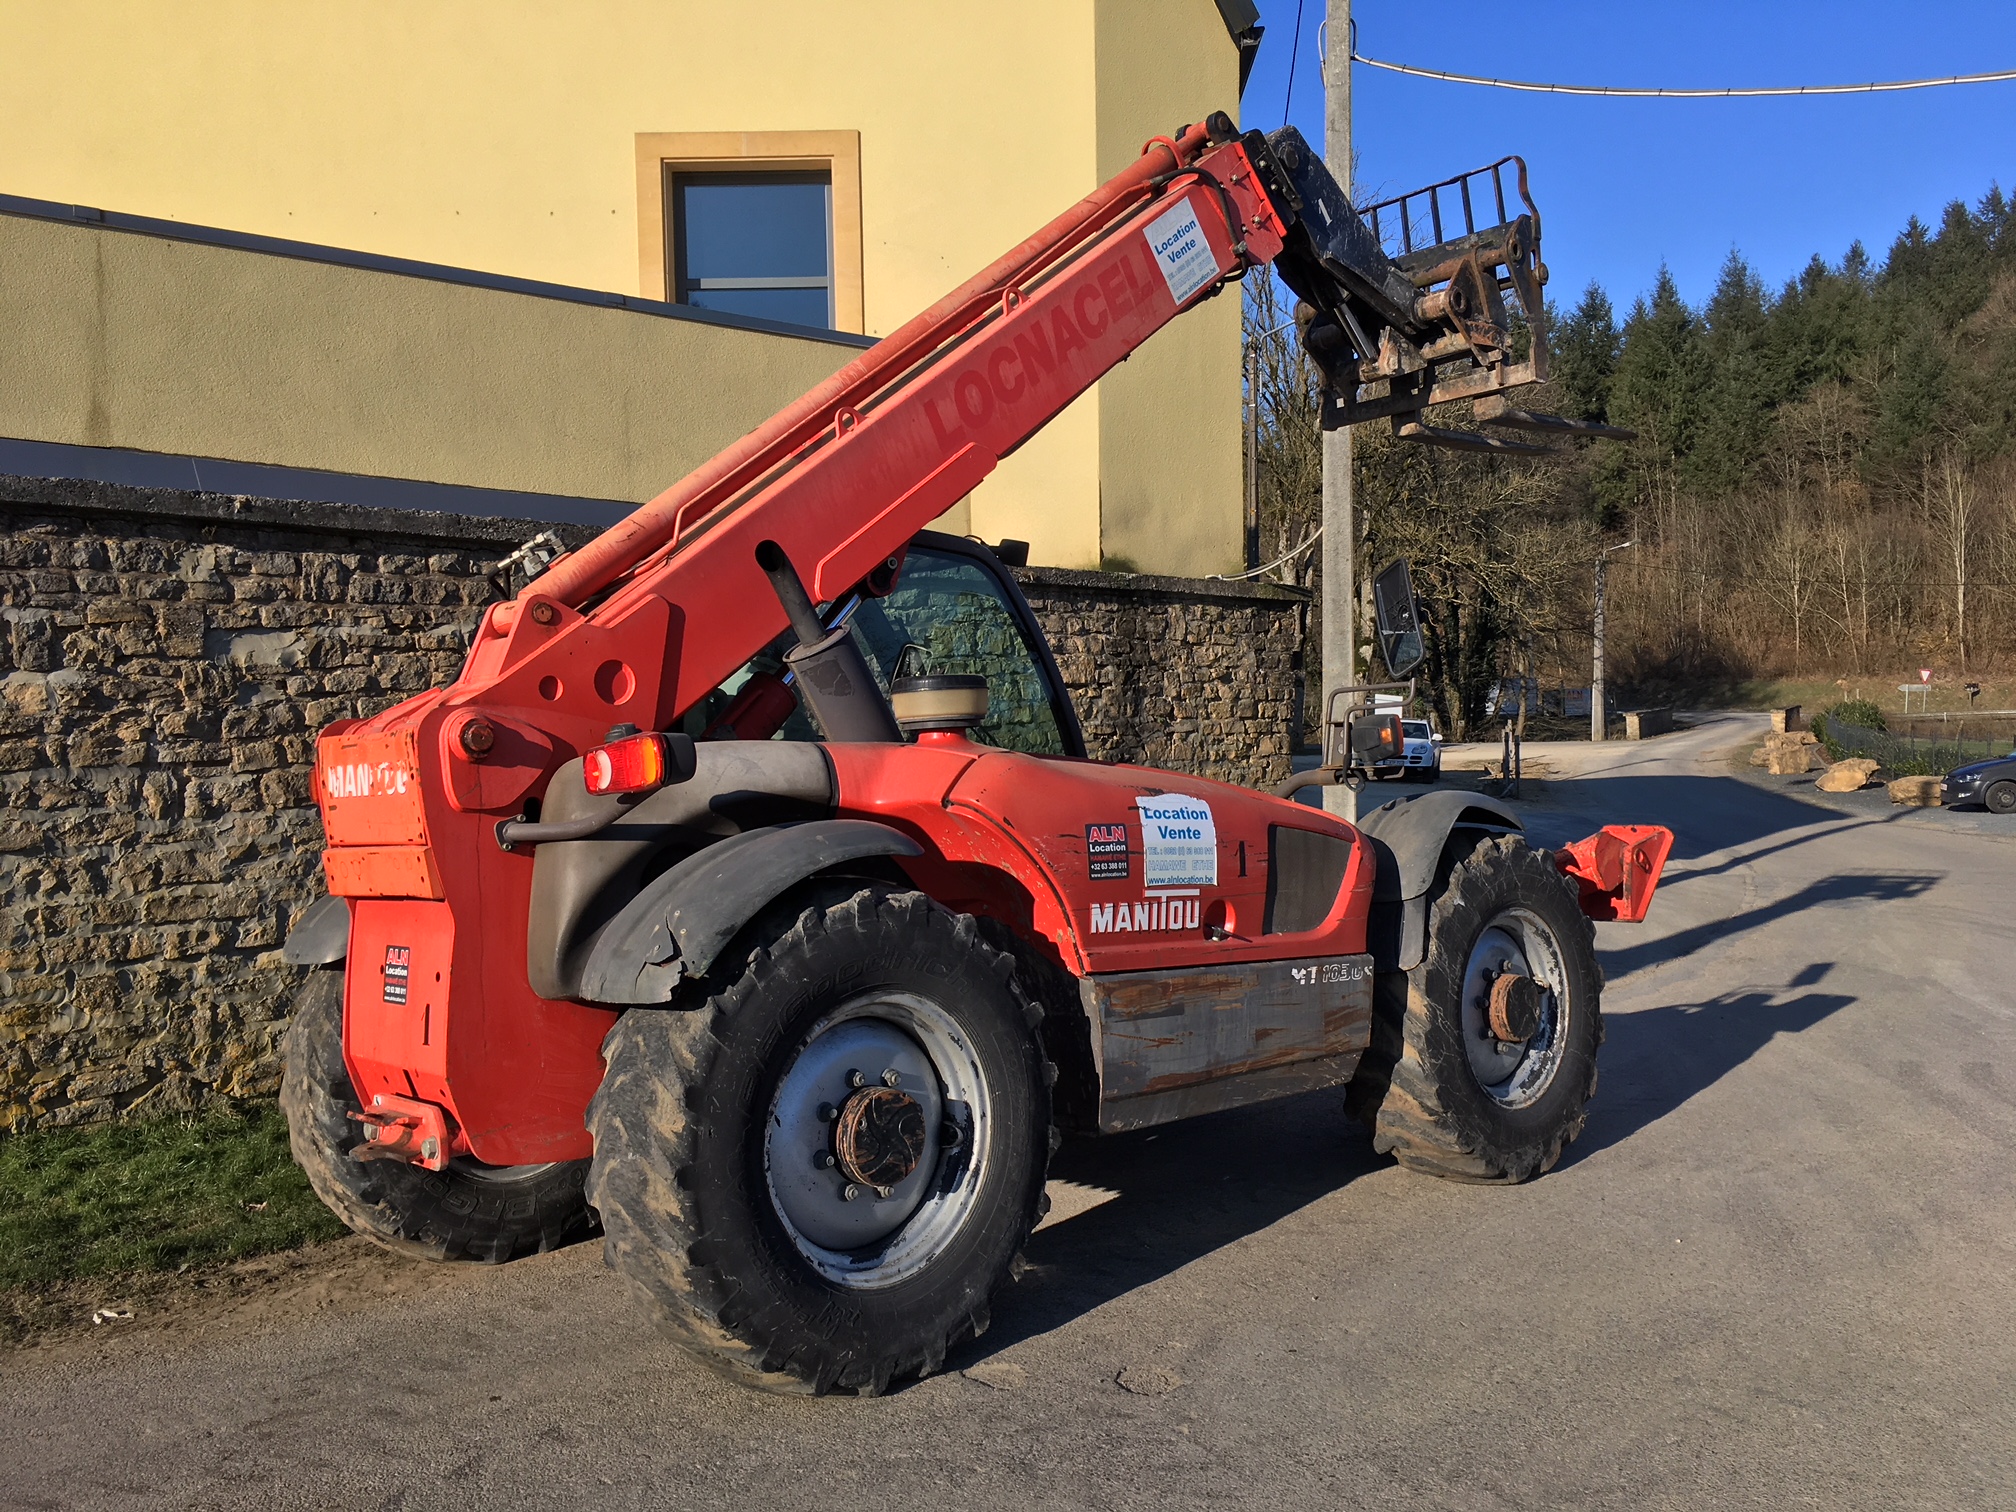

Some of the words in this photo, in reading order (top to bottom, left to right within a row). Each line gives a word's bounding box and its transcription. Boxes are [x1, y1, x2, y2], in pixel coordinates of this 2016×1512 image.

[1154, 220, 1197, 256] Location
[1167, 239, 1197, 264] Vente
[1144, 806, 1208, 821] Location
[1089, 826, 1125, 842] ALN
[1158, 825, 1201, 840] Vente
[1089, 843, 1126, 853] Location
[1148, 875, 1214, 884] www.alnlocation.be
[1089, 888, 1200, 934] MANITOU
[386, 948, 409, 966] ALN
